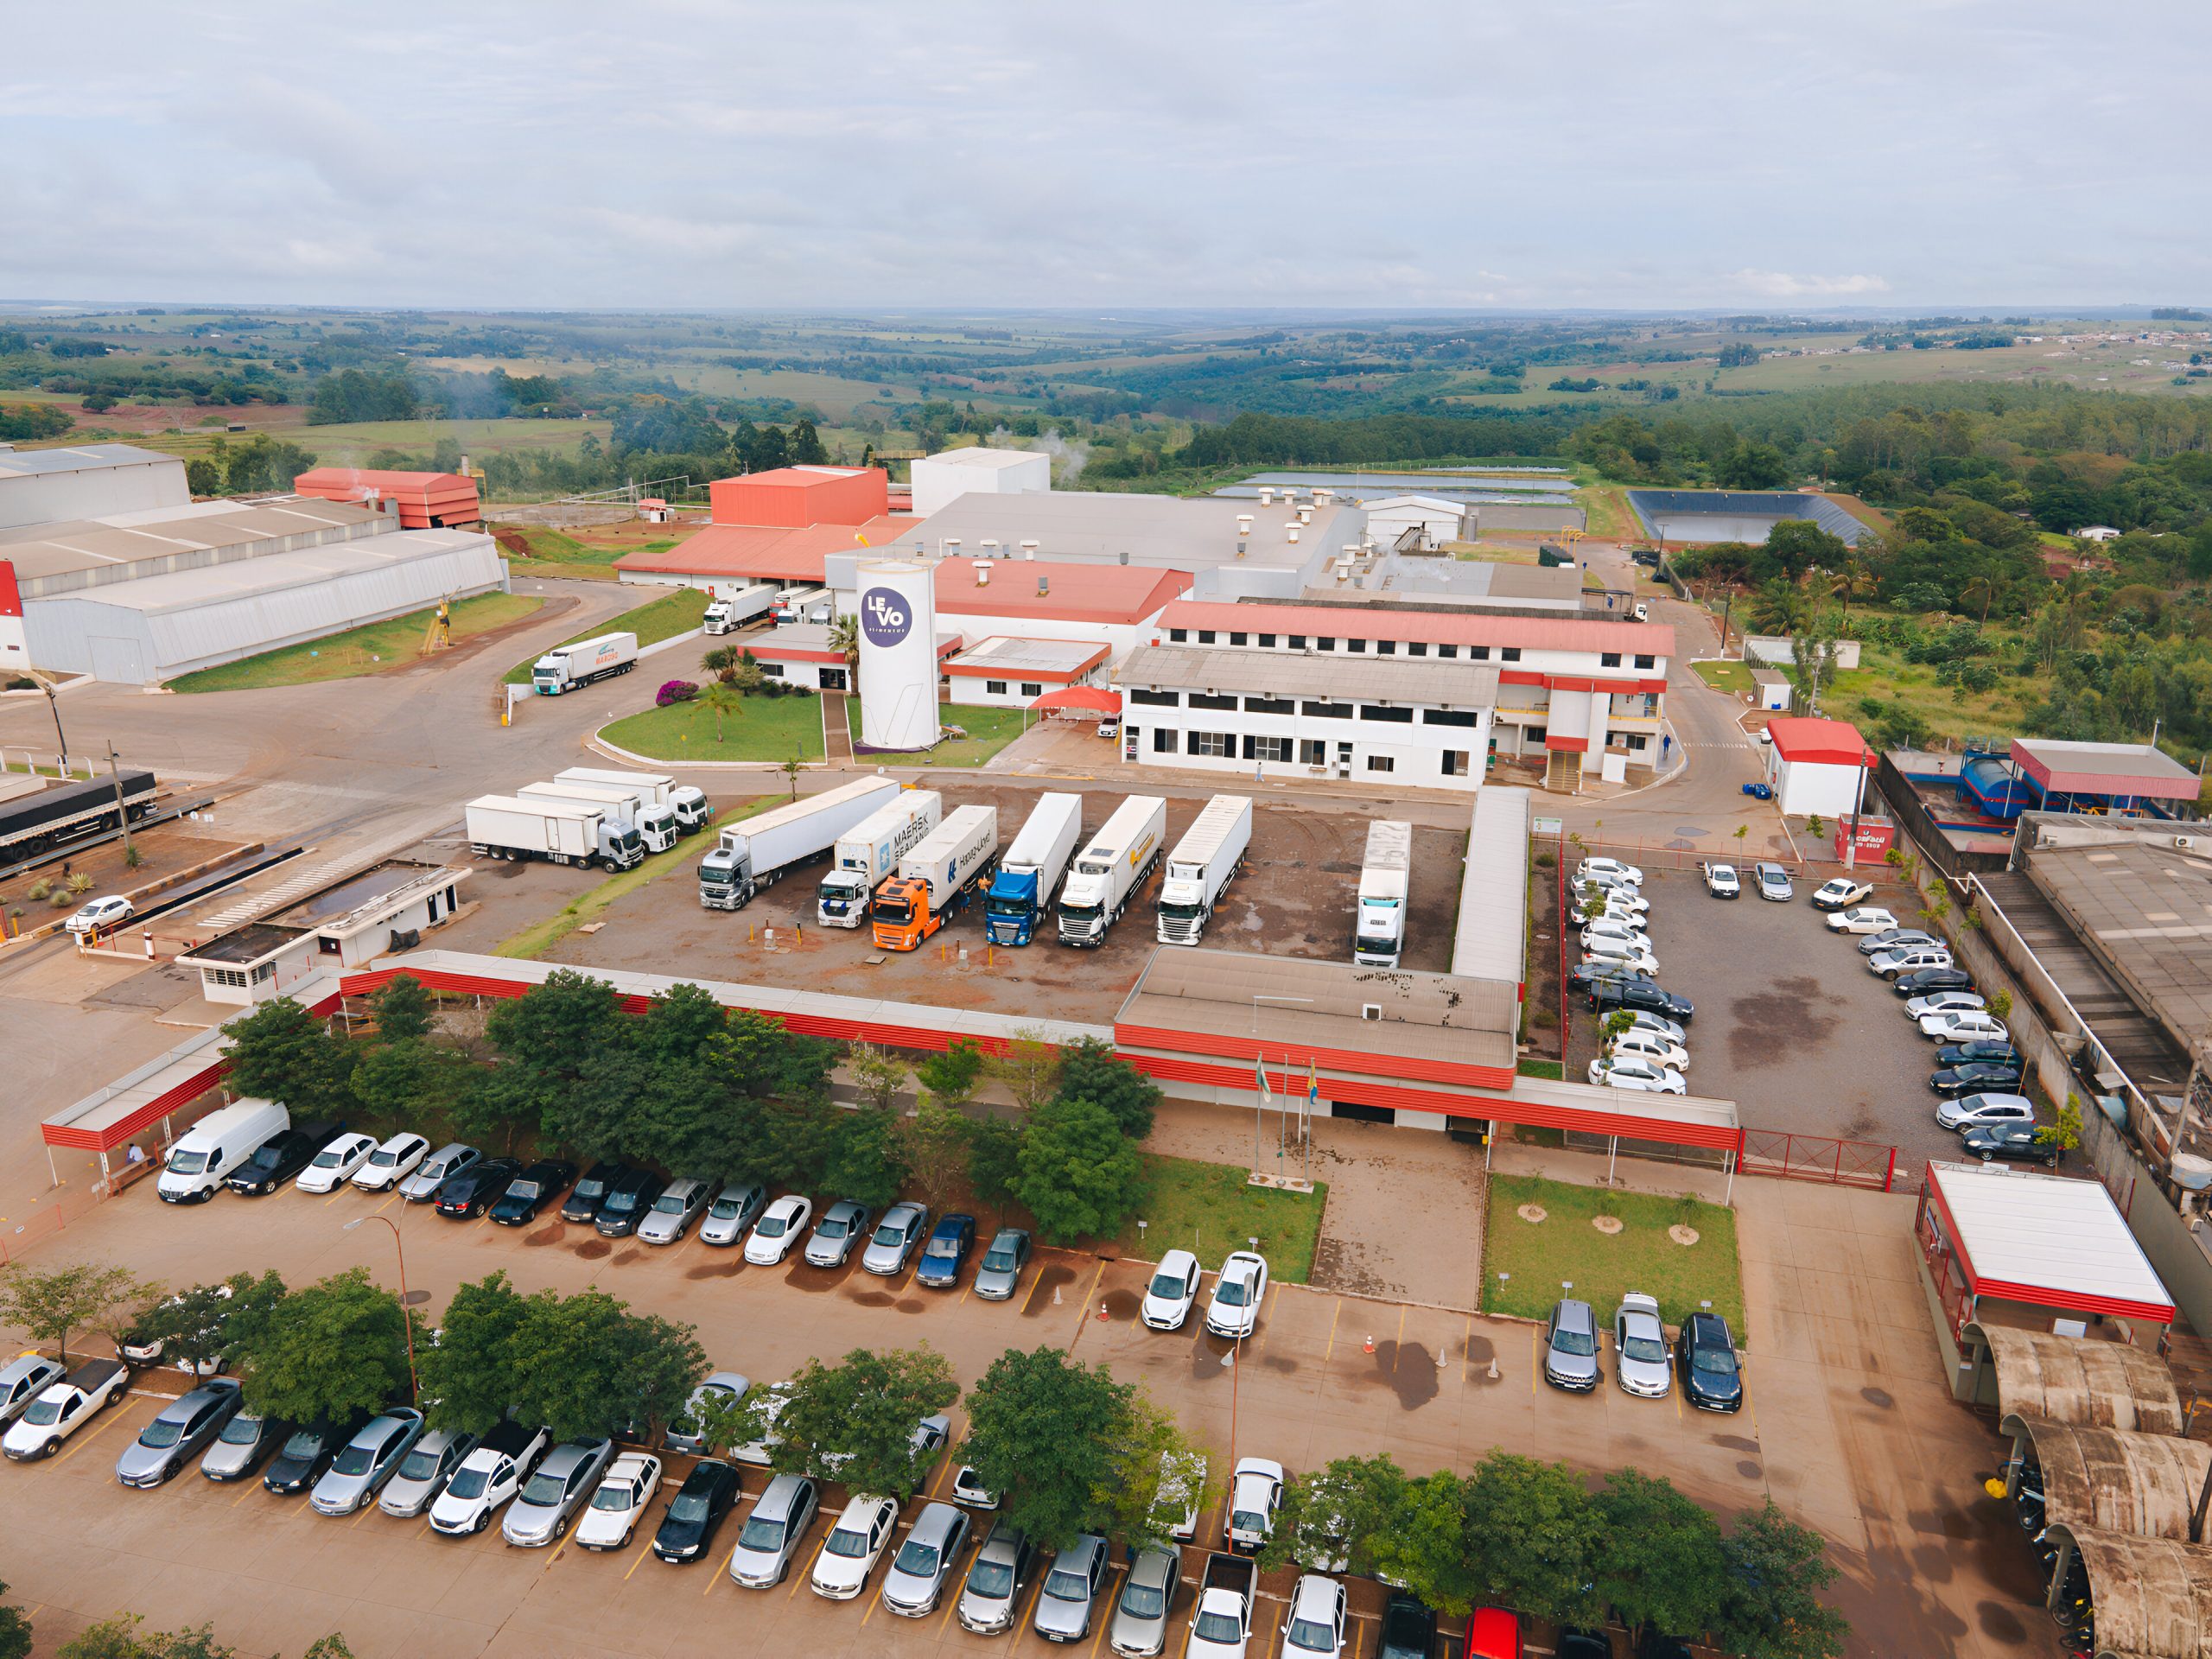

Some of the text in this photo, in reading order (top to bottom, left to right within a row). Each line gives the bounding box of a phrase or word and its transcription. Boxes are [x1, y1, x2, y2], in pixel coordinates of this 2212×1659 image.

[868, 596, 886, 612] LE
[876, 607, 904, 626] VO
[894, 811, 929, 849] MAERSK
